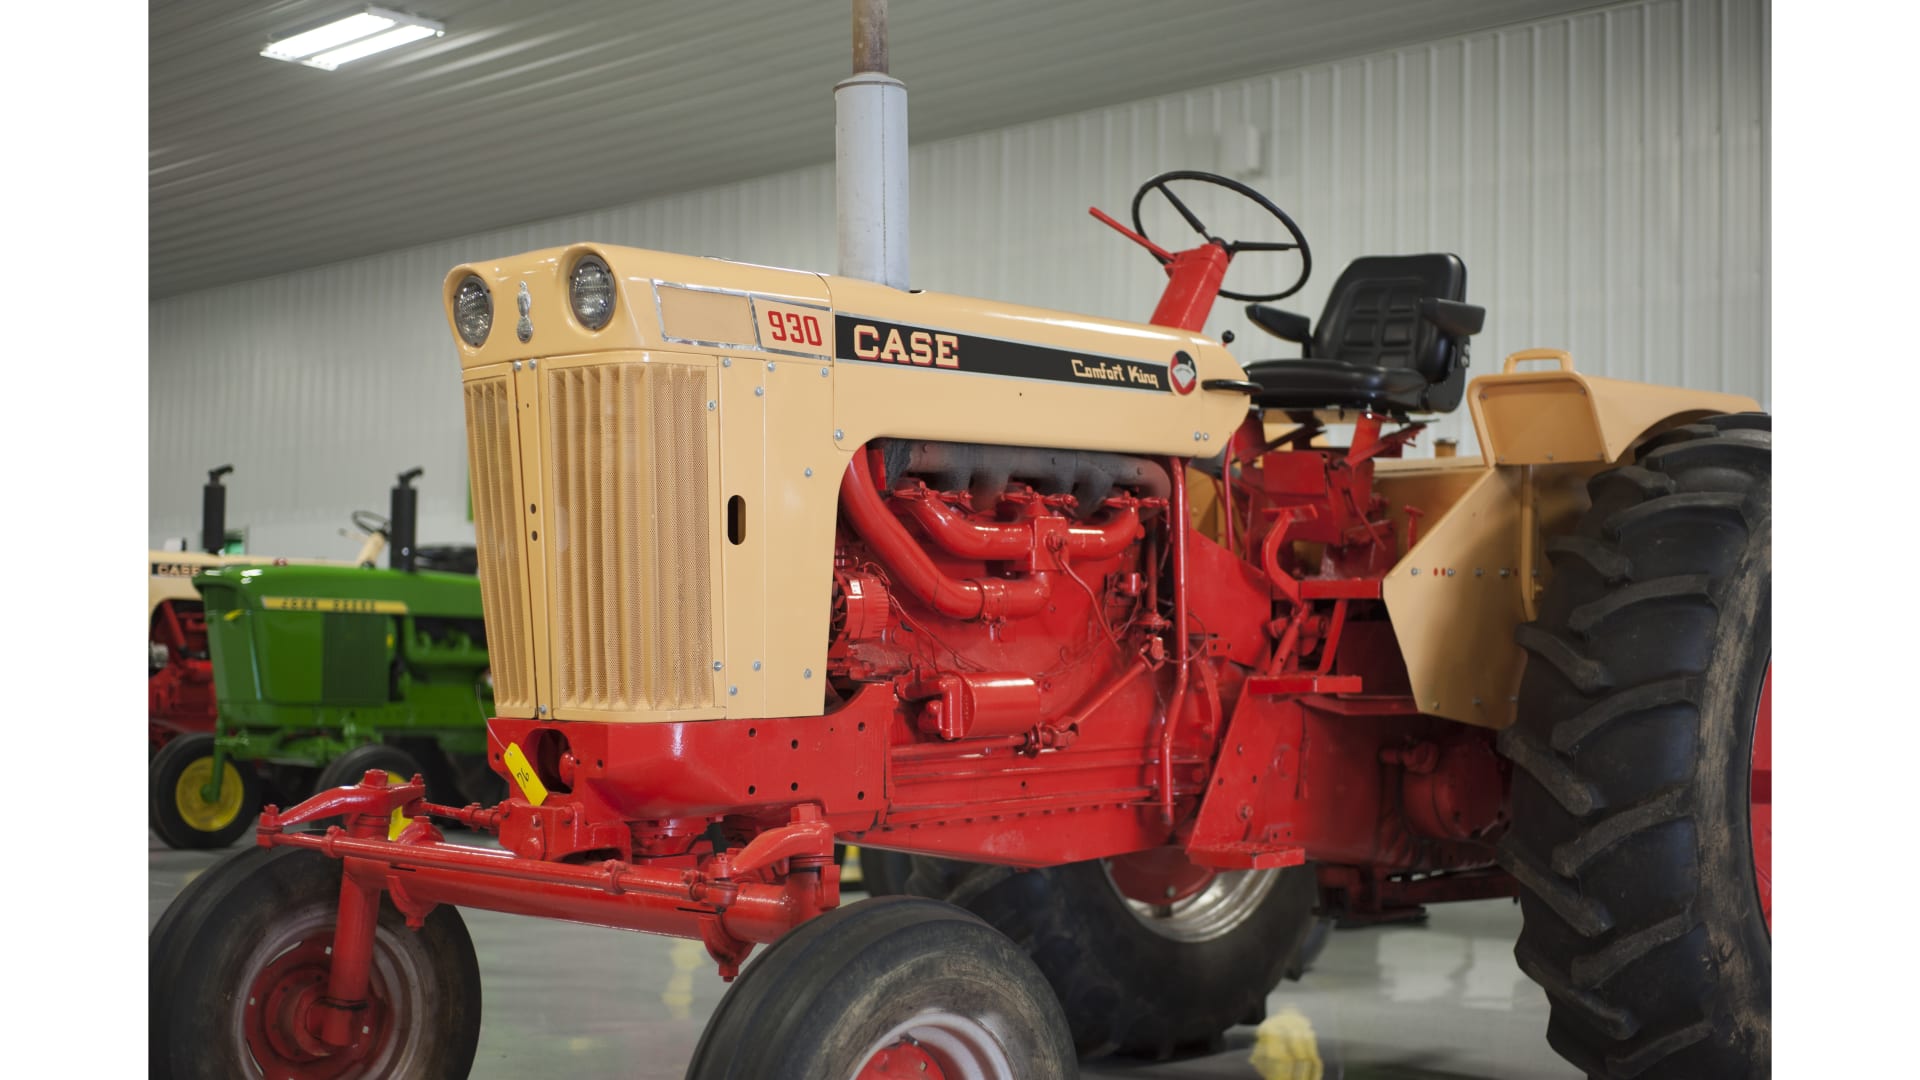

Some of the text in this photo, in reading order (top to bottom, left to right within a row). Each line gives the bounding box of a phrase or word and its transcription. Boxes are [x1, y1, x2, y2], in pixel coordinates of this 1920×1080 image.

[768, 310, 822, 347] 930
[853, 324, 960, 369] CASE
[1071, 359, 1160, 389] Comfort King
[157, 562, 201, 577] CASE
[516, 767, 530, 789] 76
